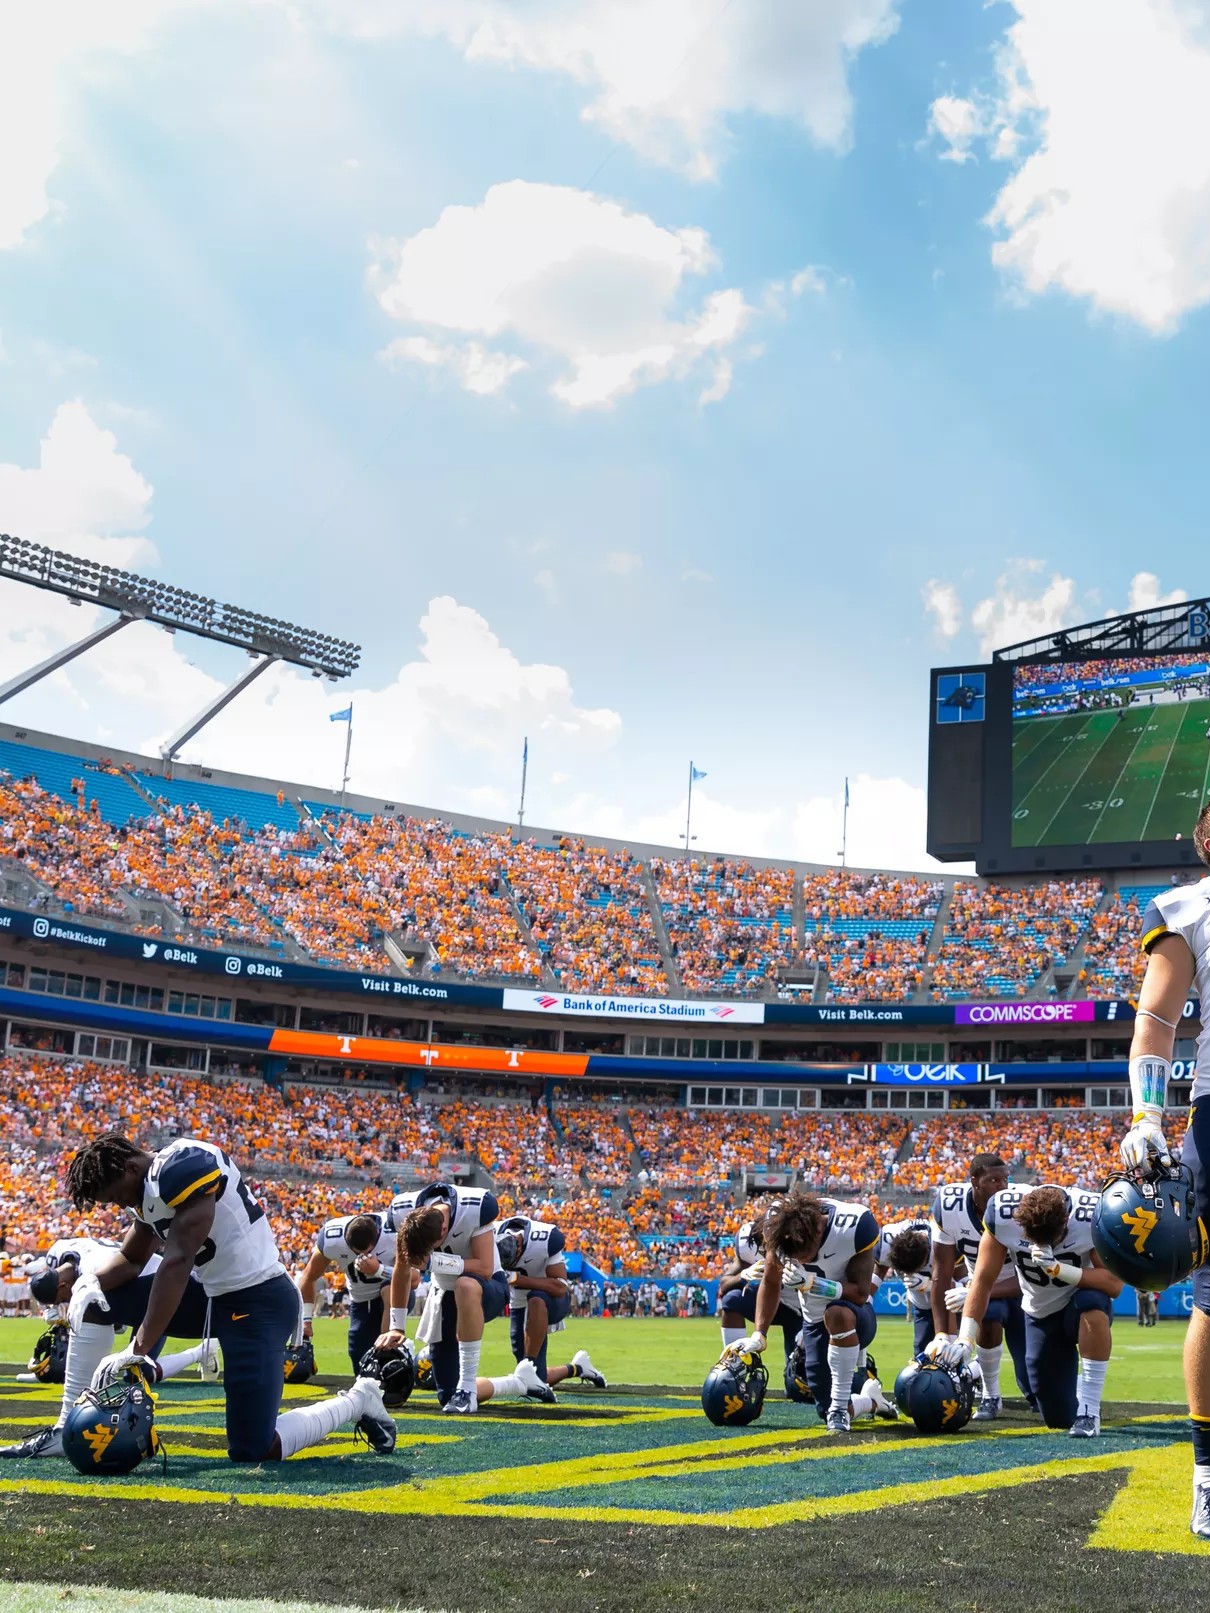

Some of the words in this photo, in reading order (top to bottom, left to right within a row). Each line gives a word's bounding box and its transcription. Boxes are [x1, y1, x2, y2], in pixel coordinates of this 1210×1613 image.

[50, 927, 107, 948] #BelkKickoff
[164, 948, 198, 964] @Belk
[246, 963, 283, 978] @Belk
[361, 978, 390, 993] Visit
[393, 982, 448, 998] Belk.com
[563, 998, 593, 1010] Bank
[594, 999, 606, 1012] of
[608, 1001, 657, 1015] America
[659, 1003, 705, 1016] Stadium
[818, 1010, 845, 1020] Visit
[849, 1009, 903, 1020] Belk.com
[942, 1187, 964, 1212] 85
[999, 1192, 1024, 1220] 88
[1075, 1195, 1101, 1222] 88
